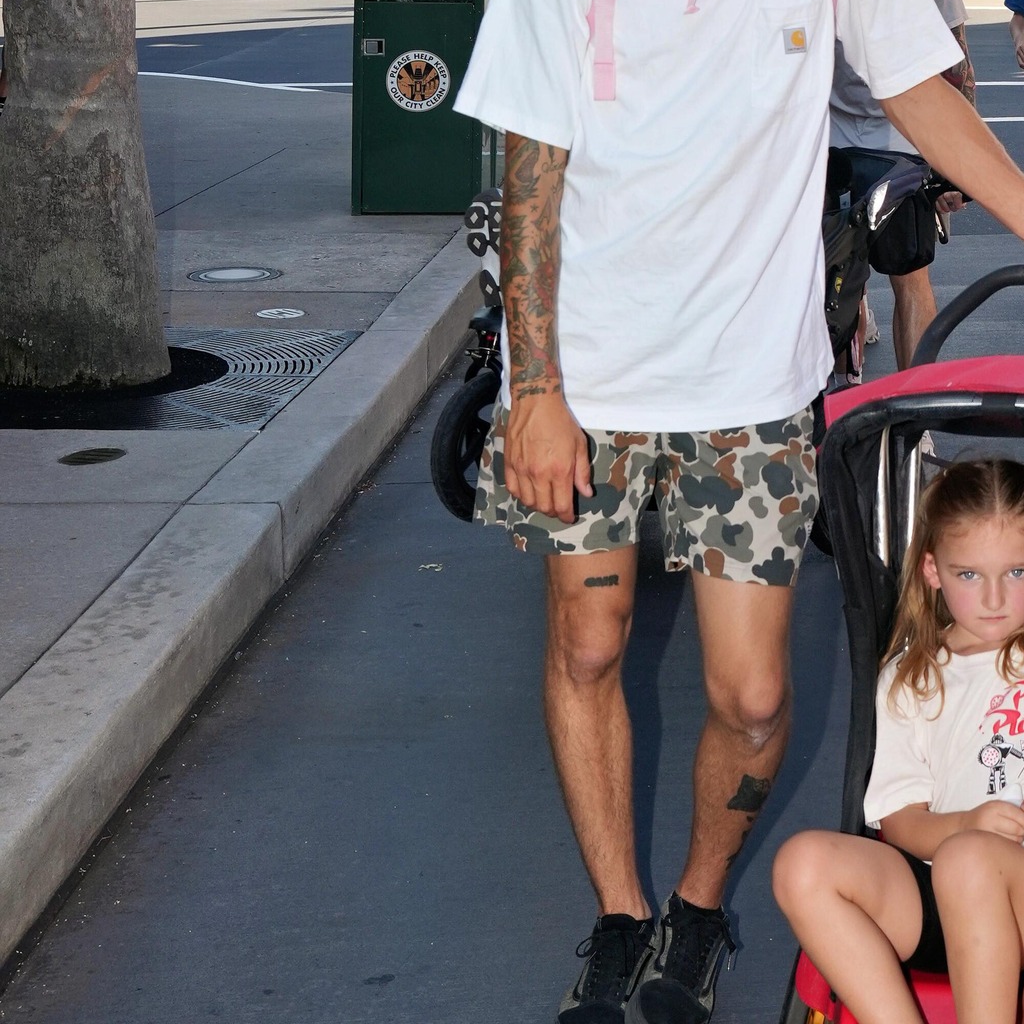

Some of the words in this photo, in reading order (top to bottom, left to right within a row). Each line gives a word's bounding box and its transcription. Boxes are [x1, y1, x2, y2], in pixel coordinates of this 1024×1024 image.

[390, 55, 411, 78] PLEASE
[414, 54, 434, 62] HELP
[434, 61, 448, 79] KEEP
[391, 87, 404, 103] OUR
[405, 101, 424, 109] CITY
[426, 88, 446, 107] CLEAN
